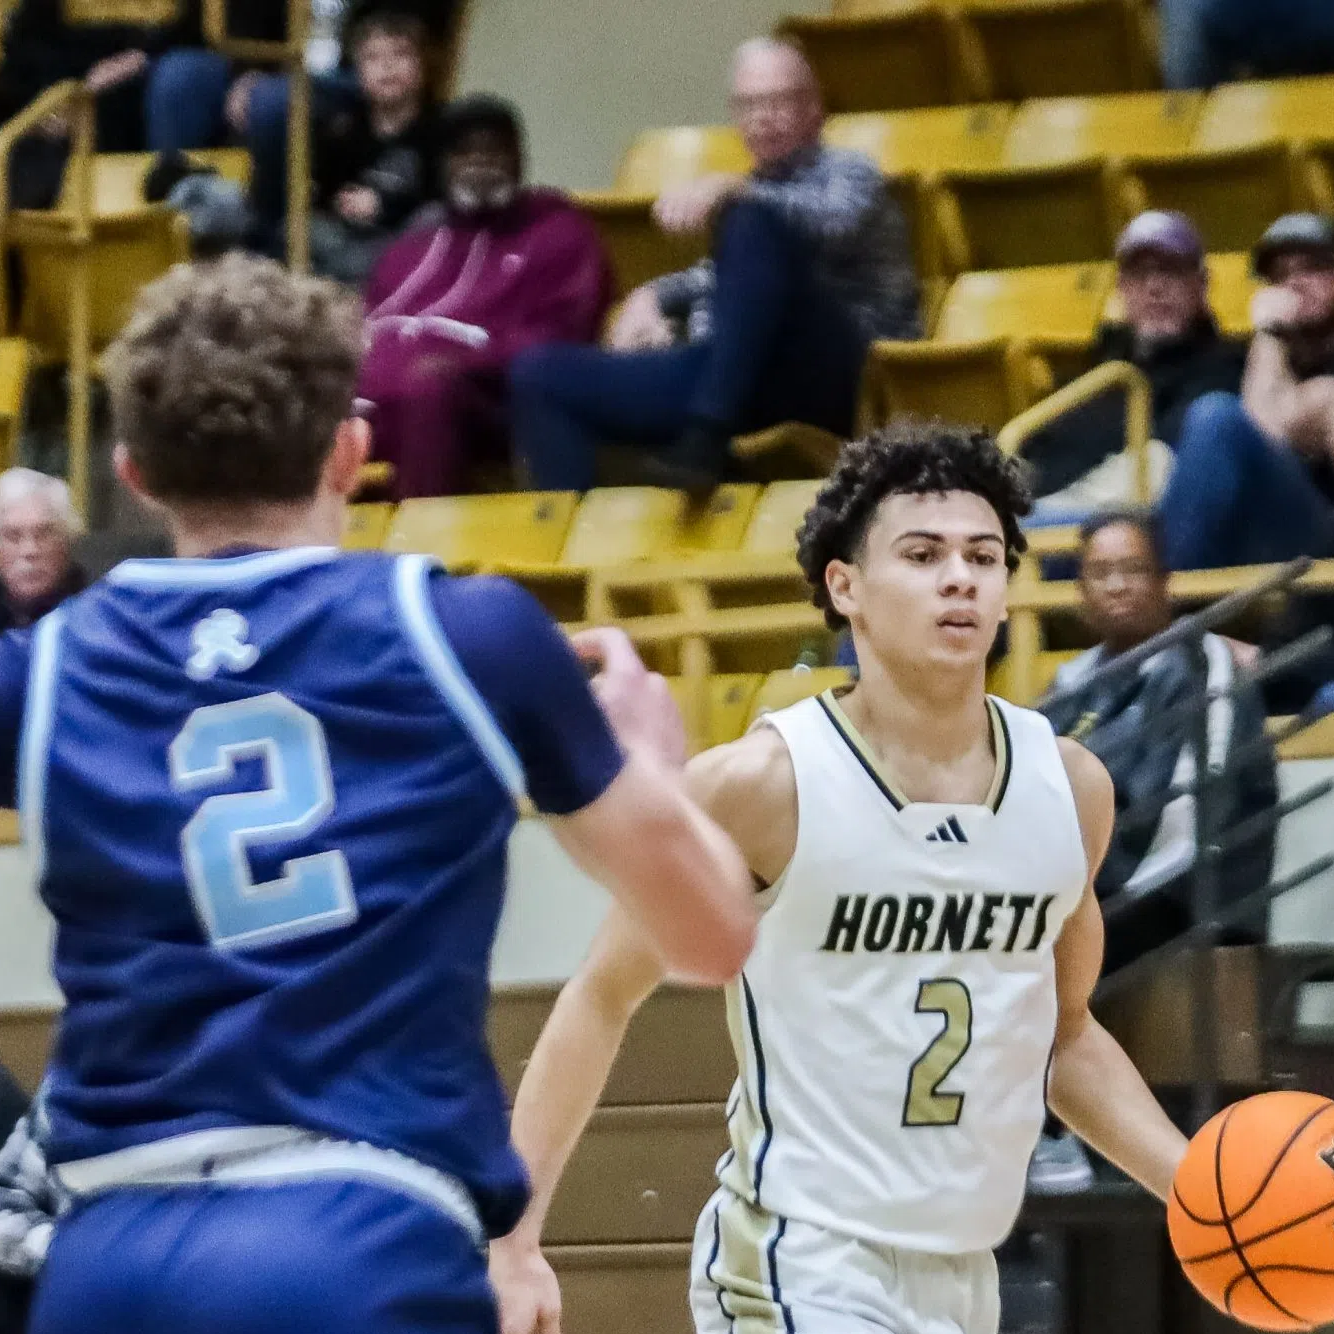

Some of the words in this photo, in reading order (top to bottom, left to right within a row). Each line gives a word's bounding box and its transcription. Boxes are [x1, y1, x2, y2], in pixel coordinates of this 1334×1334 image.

[169, 692, 359, 950] 2
[820, 893, 1059, 952] HORNETS
[901, 976, 972, 1127] 2
